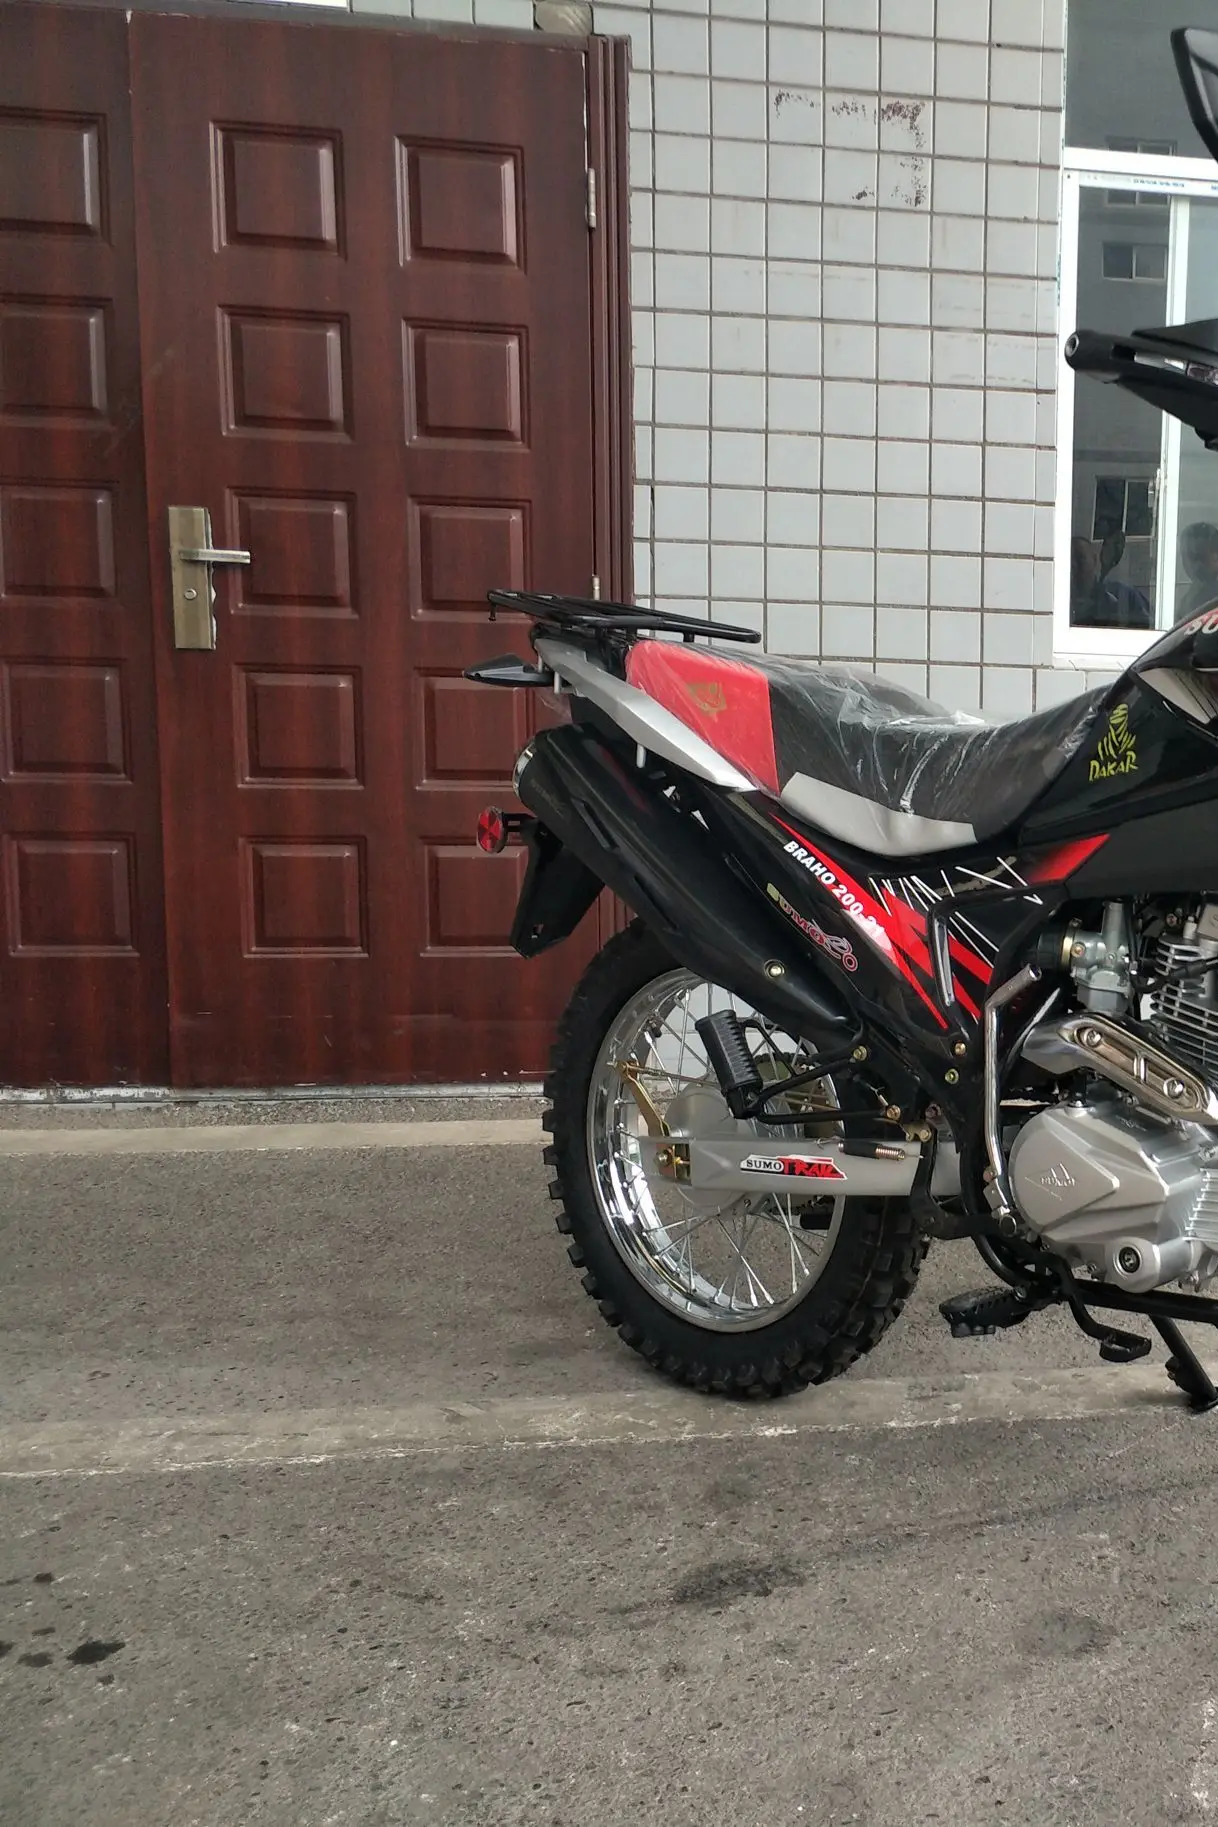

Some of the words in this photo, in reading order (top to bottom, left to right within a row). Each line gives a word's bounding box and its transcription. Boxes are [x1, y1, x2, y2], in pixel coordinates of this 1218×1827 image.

[783, 840, 837, 886] BRAHO
[766, 882, 827, 946] UMO
[746, 1159, 783, 1171] SUMO
